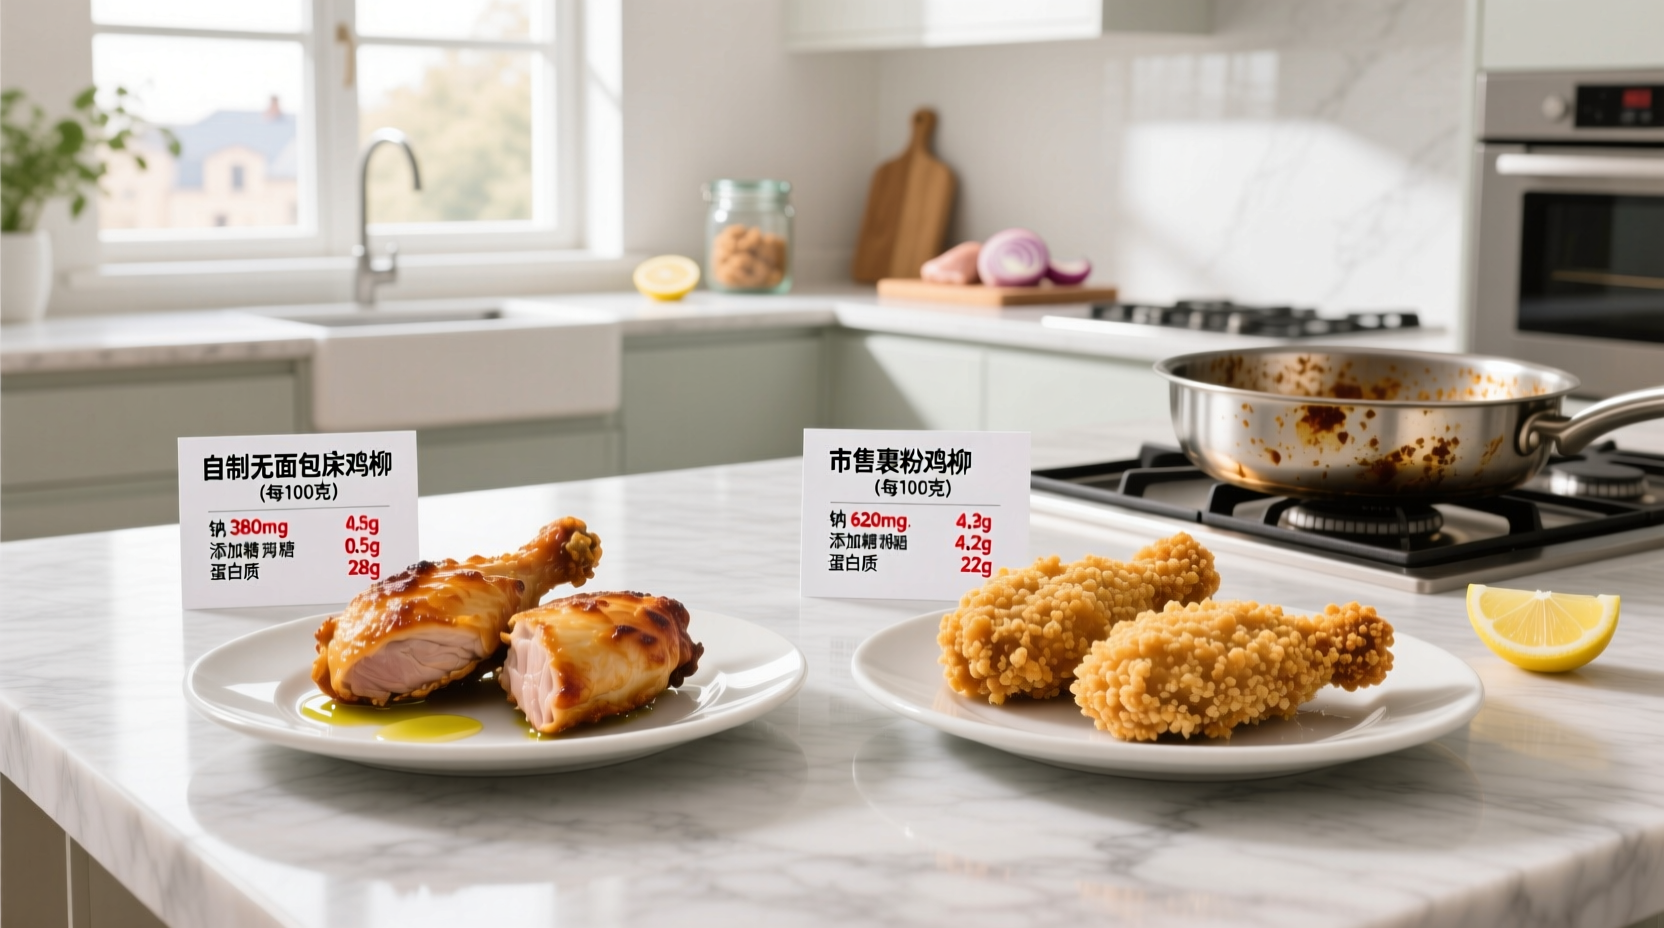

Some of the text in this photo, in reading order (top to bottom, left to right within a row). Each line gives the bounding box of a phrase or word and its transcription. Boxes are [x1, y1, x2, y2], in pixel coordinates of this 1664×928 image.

[260, 480, 338, 502] (每100克)
[875, 478, 951, 498] (每100克)
[230, 519, 288, 538] 380mg
[955, 513, 992, 532] 4.3g
[345, 537, 380, 557] 0.5g
[955, 535, 992, 555] 4.2g
[210, 562, 259, 581] 蛋白质
[348, 560, 380, 580] 28g
[828, 554, 878, 572] 蛋白质
[960, 556, 992, 578] 22g
